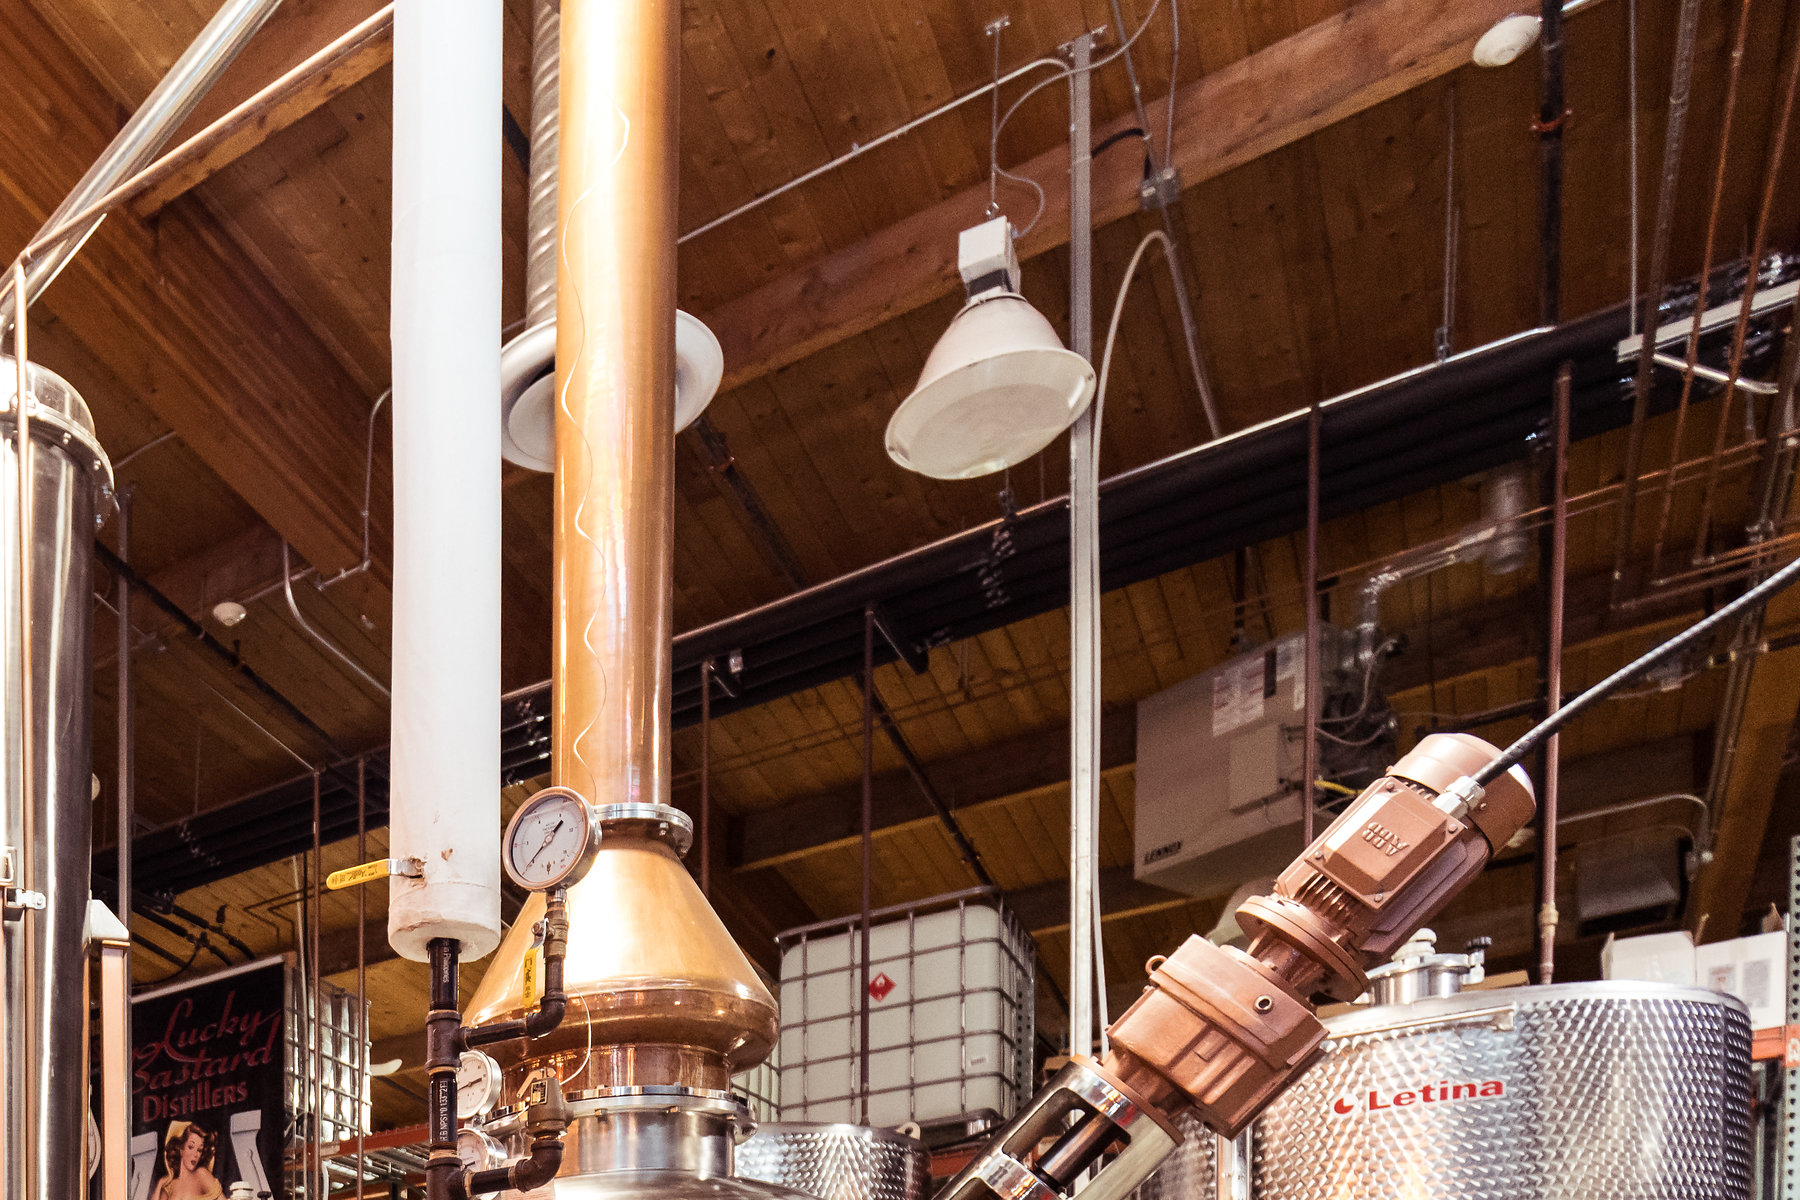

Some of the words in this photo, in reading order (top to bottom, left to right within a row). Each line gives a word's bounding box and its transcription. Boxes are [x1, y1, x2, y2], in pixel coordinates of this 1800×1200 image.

[1361, 821, 1410, 857] ABB
[138, 990, 281, 1059] Lucky
[1368, 1079, 1505, 1112] Letina
